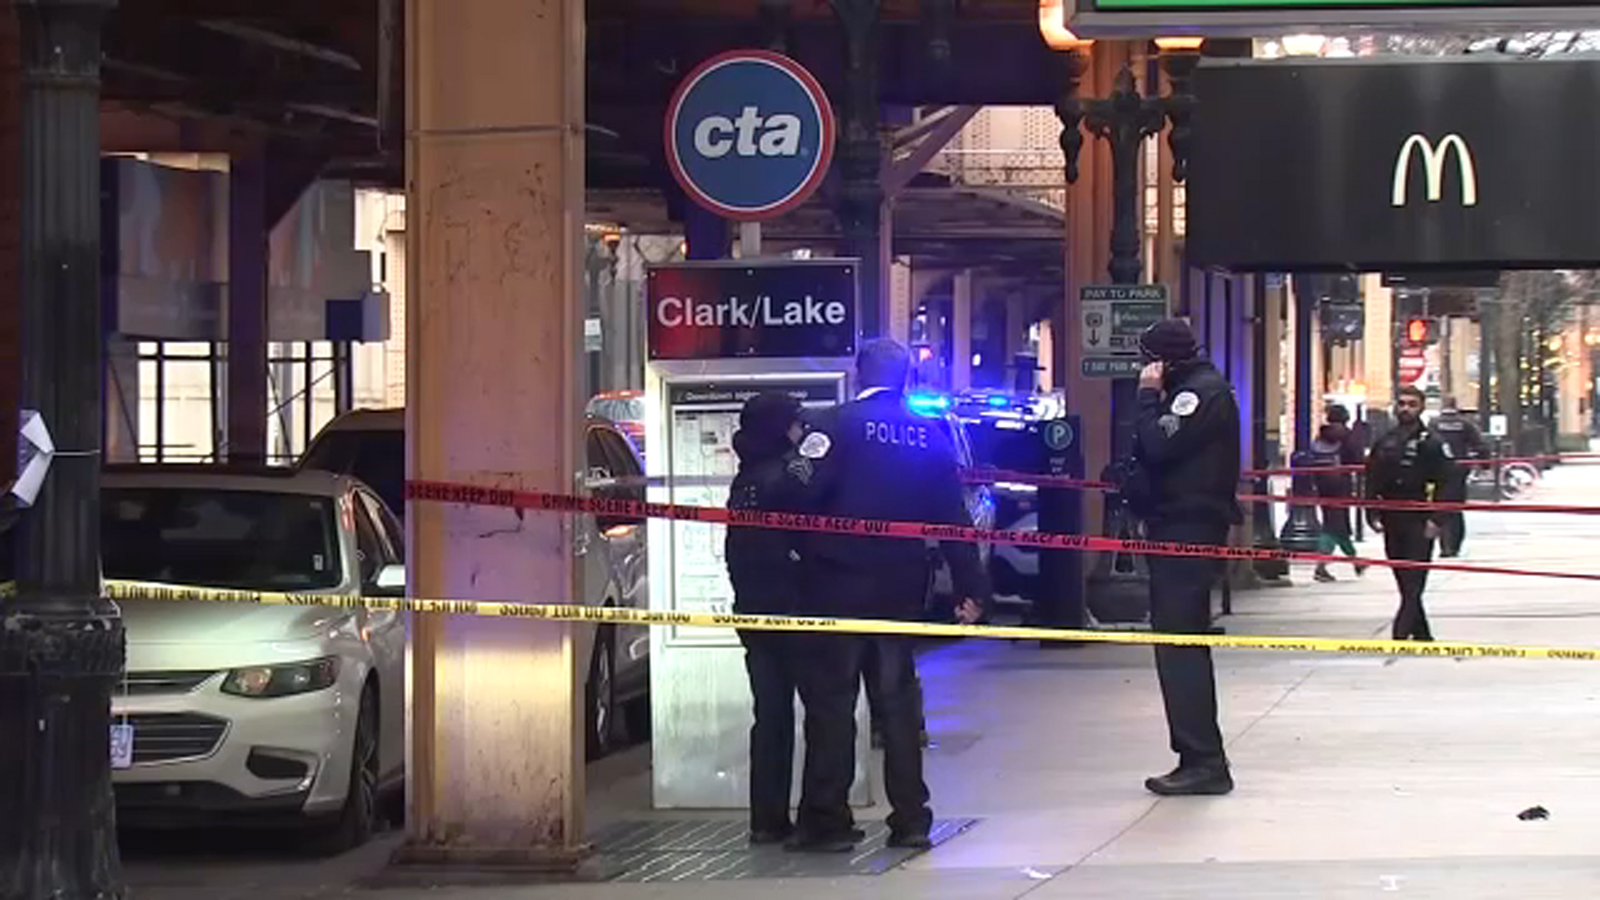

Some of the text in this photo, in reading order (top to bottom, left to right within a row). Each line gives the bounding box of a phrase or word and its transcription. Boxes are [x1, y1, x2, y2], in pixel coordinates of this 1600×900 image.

[694, 106, 801, 158] cta
[1084, 288, 1161, 299] PAY TO PARK
[657, 296, 846, 328] Clark/Lake
[866, 421, 928, 448] POLICE
[1053, 425, 1066, 444] P
[453, 486, 486, 503] KEEP
[489, 489, 515, 506] OUT
[541, 493, 587, 511] CRIME
[590, 498, 632, 515] SCENE
[635, 502, 669, 518] KEEP
